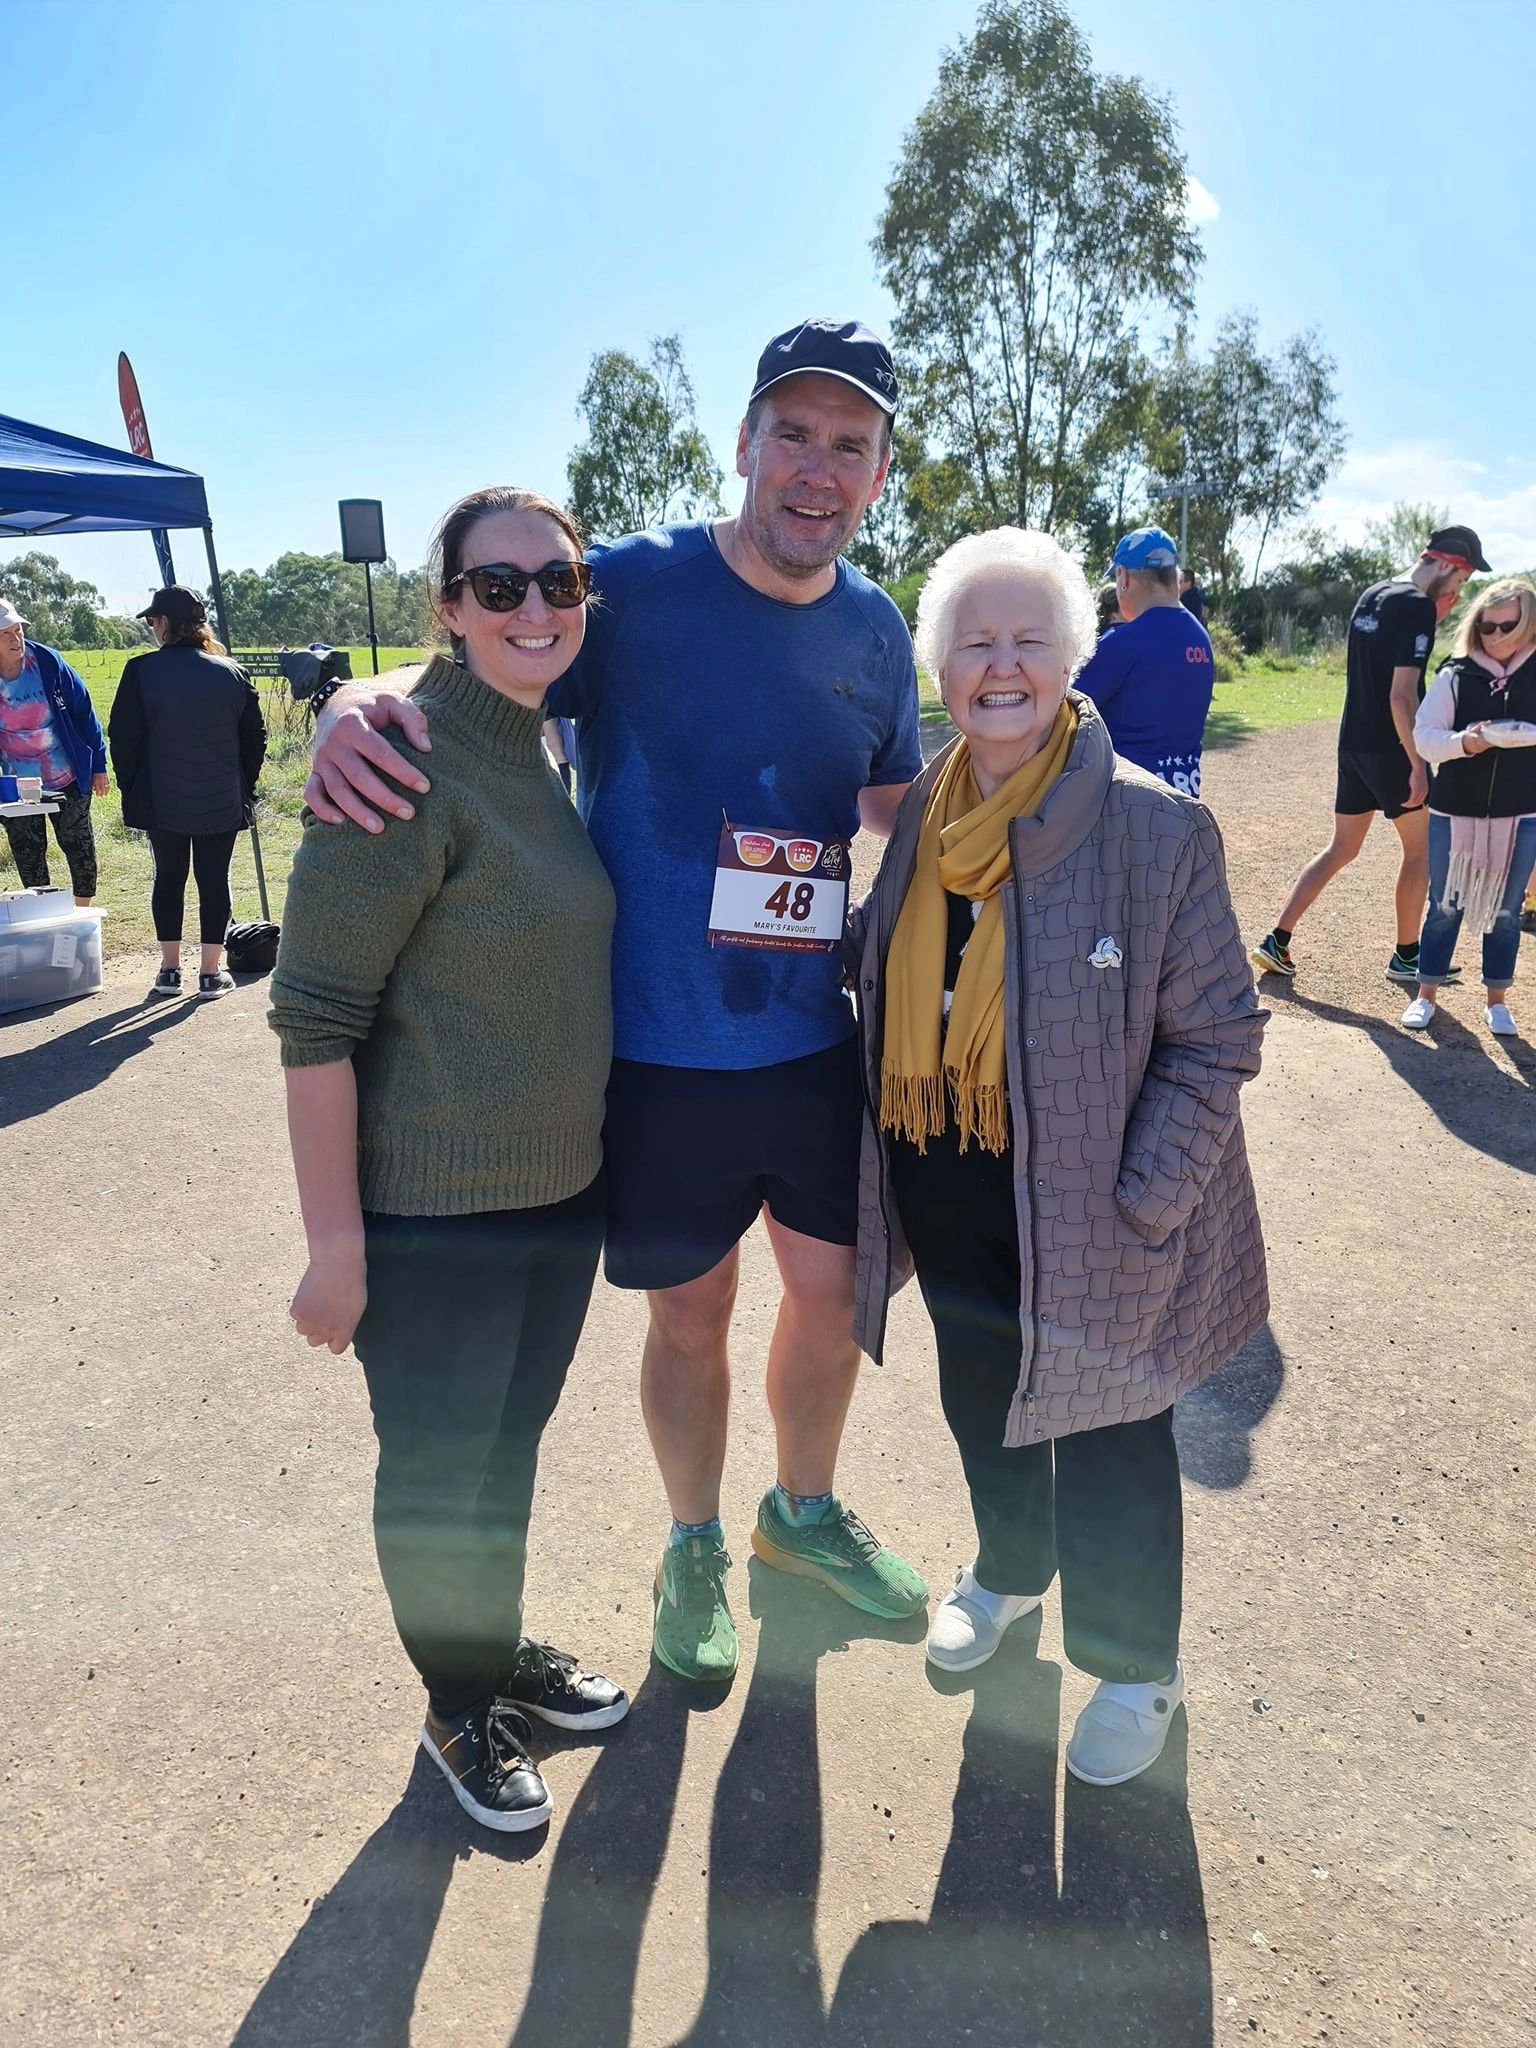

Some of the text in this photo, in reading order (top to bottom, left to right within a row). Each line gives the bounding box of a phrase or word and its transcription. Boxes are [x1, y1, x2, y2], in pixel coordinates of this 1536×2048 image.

[1185, 646, 1210, 664] COL
[793, 852, 812, 864] LRC
[764, 881, 815, 921] 48
[753, 921, 817, 934] MARY'S FAVOURITE
